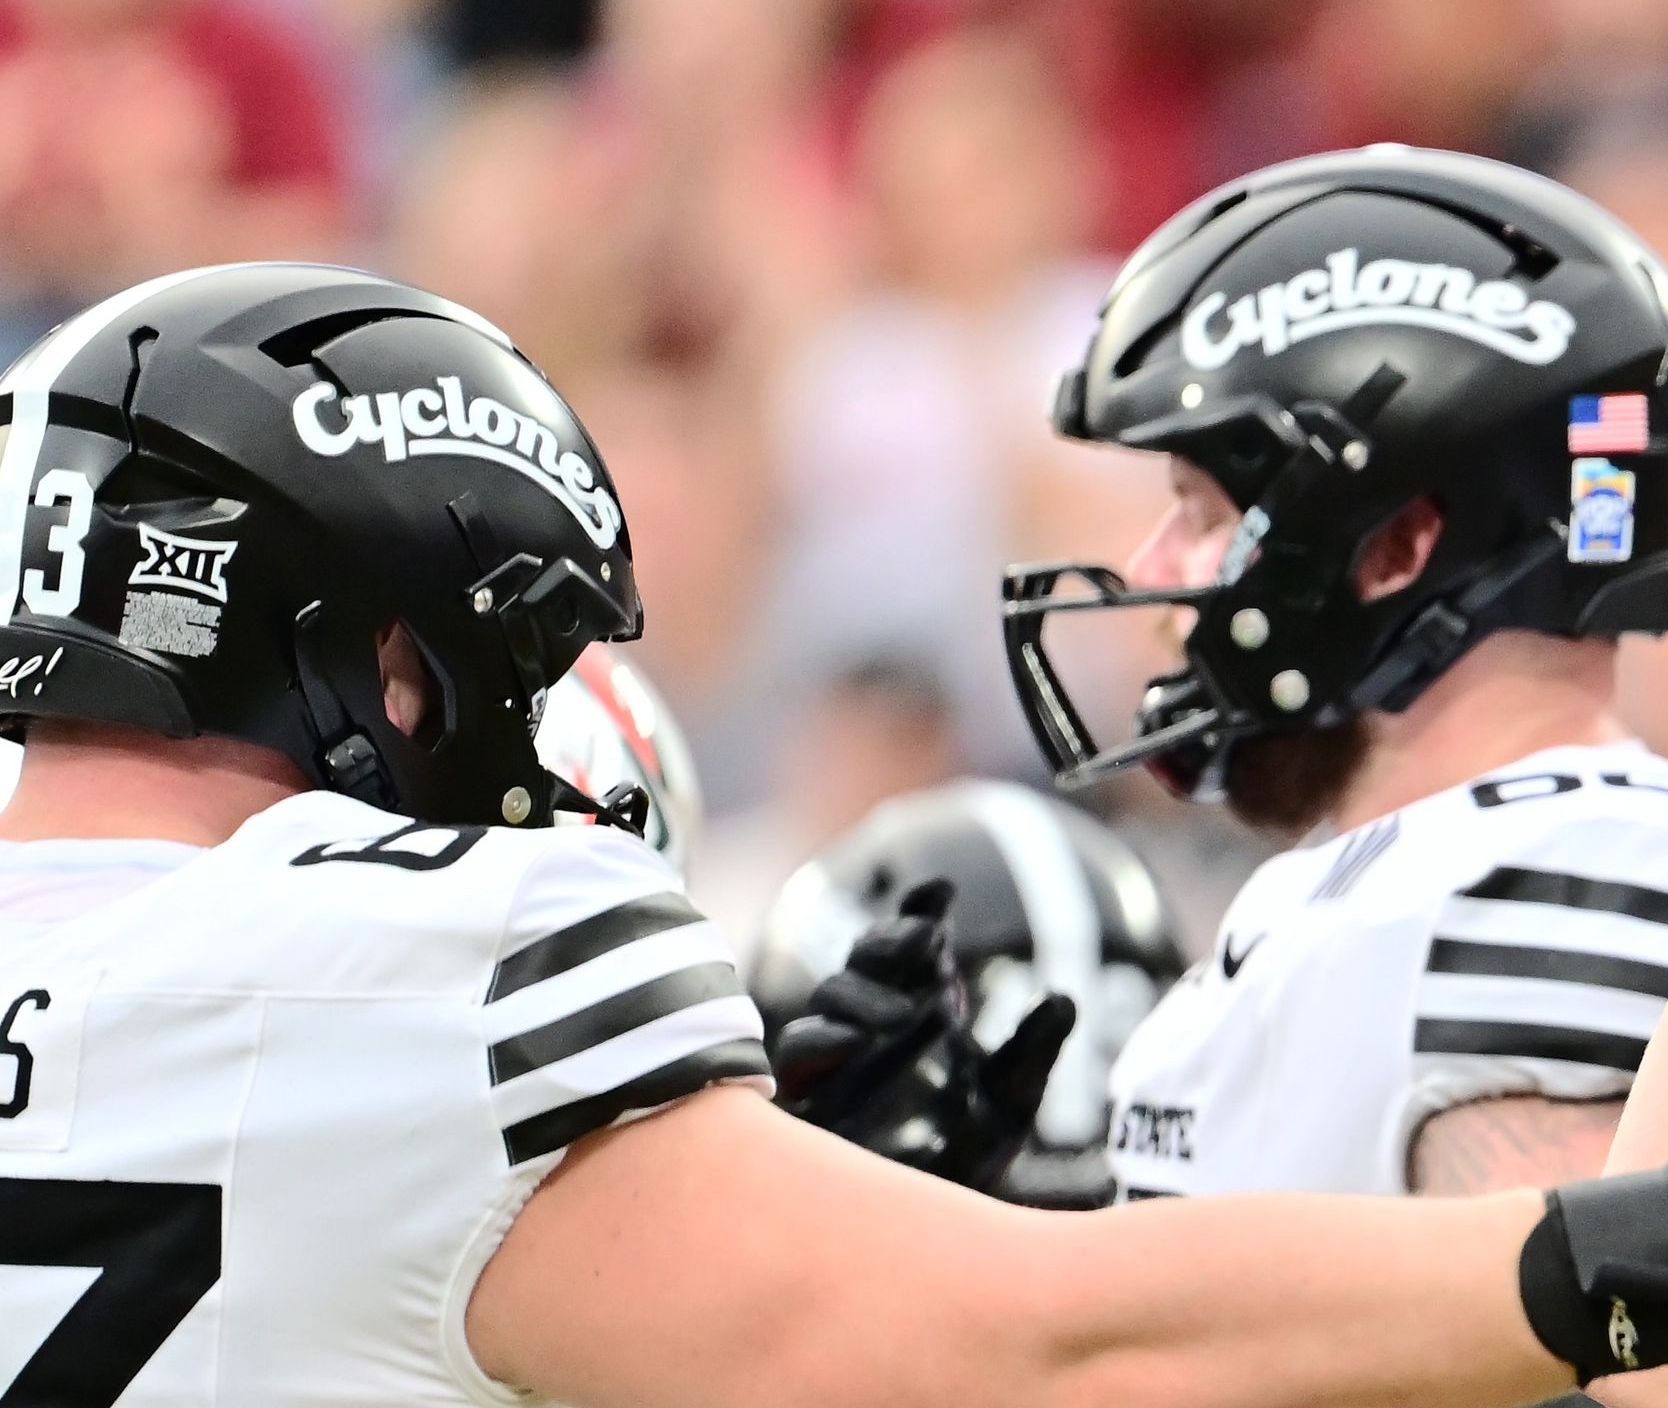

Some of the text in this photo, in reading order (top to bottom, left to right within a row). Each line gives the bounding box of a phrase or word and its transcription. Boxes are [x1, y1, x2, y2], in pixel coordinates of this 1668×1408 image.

[1180, 247, 1577, 370] Cyclones
[293, 376, 622, 550] Cyclones
[23, 470, 95, 616] 3
